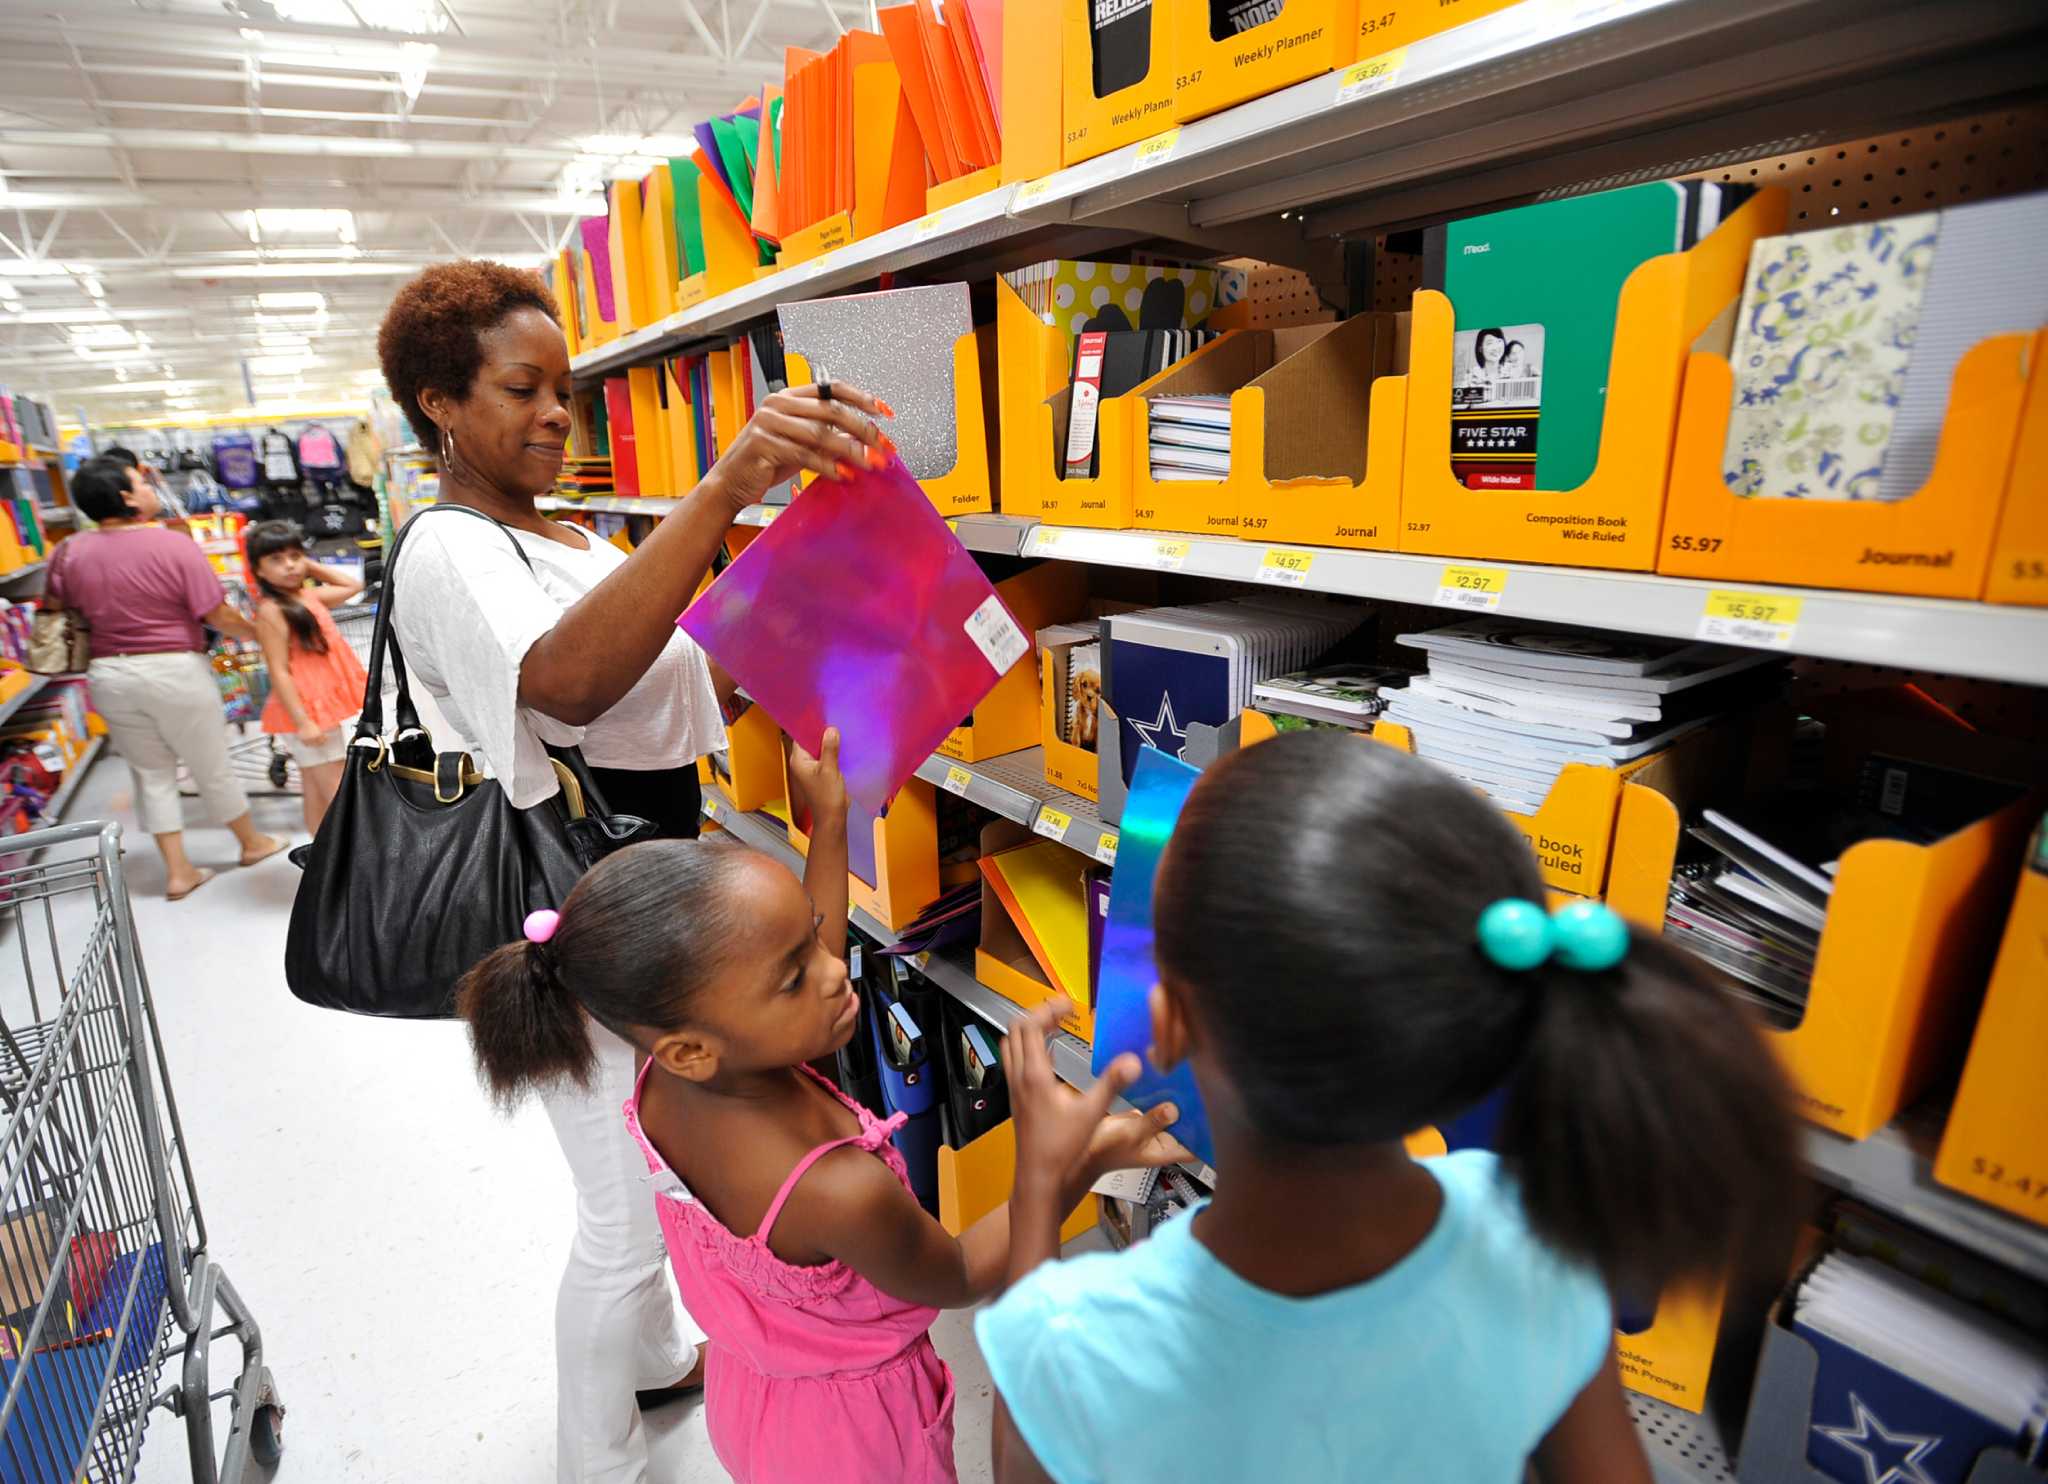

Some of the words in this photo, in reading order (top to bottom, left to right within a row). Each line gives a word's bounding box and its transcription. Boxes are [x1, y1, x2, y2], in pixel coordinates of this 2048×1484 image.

[1361, 12, 1396, 36] $3.47
[1234, 44, 1274, 67] Weekly
[1276, 27, 1323, 53] Planner
[1176, 70, 1203, 90] $3.47
[1111, 107, 1142, 127] Weekly
[1067, 128, 1088, 144] $3.47
[1458, 427, 1488, 437] FIVE
[1490, 426, 1526, 437] STAR
[952, 493, 980, 505] Folder
[1080, 499, 1106, 509] Journal
[1207, 515, 1239, 526] Journal
[1242, 517, 1267, 529] $4.97
[1407, 522, 1431, 532] $2.97
[1526, 513, 1595, 527] Composition
[1597, 516, 1627, 527] Book
[1335, 525, 1378, 538] Journal
[1562, 529, 1590, 541] Wide
[1592, 531, 1626, 542] Ruled
[1671, 534, 1723, 553] $5.97
[1275, 557, 1302, 570] $4.97
[1857, 548, 1955, 568] Journal
[1456, 575, 1490, 591] $2.97
[1727, 603, 1777, 621] $5.97
[1539, 835, 1584, 859] book
[1536, 854, 1582, 875] ruled
[1642, 1369, 1687, 1392] Prongs
